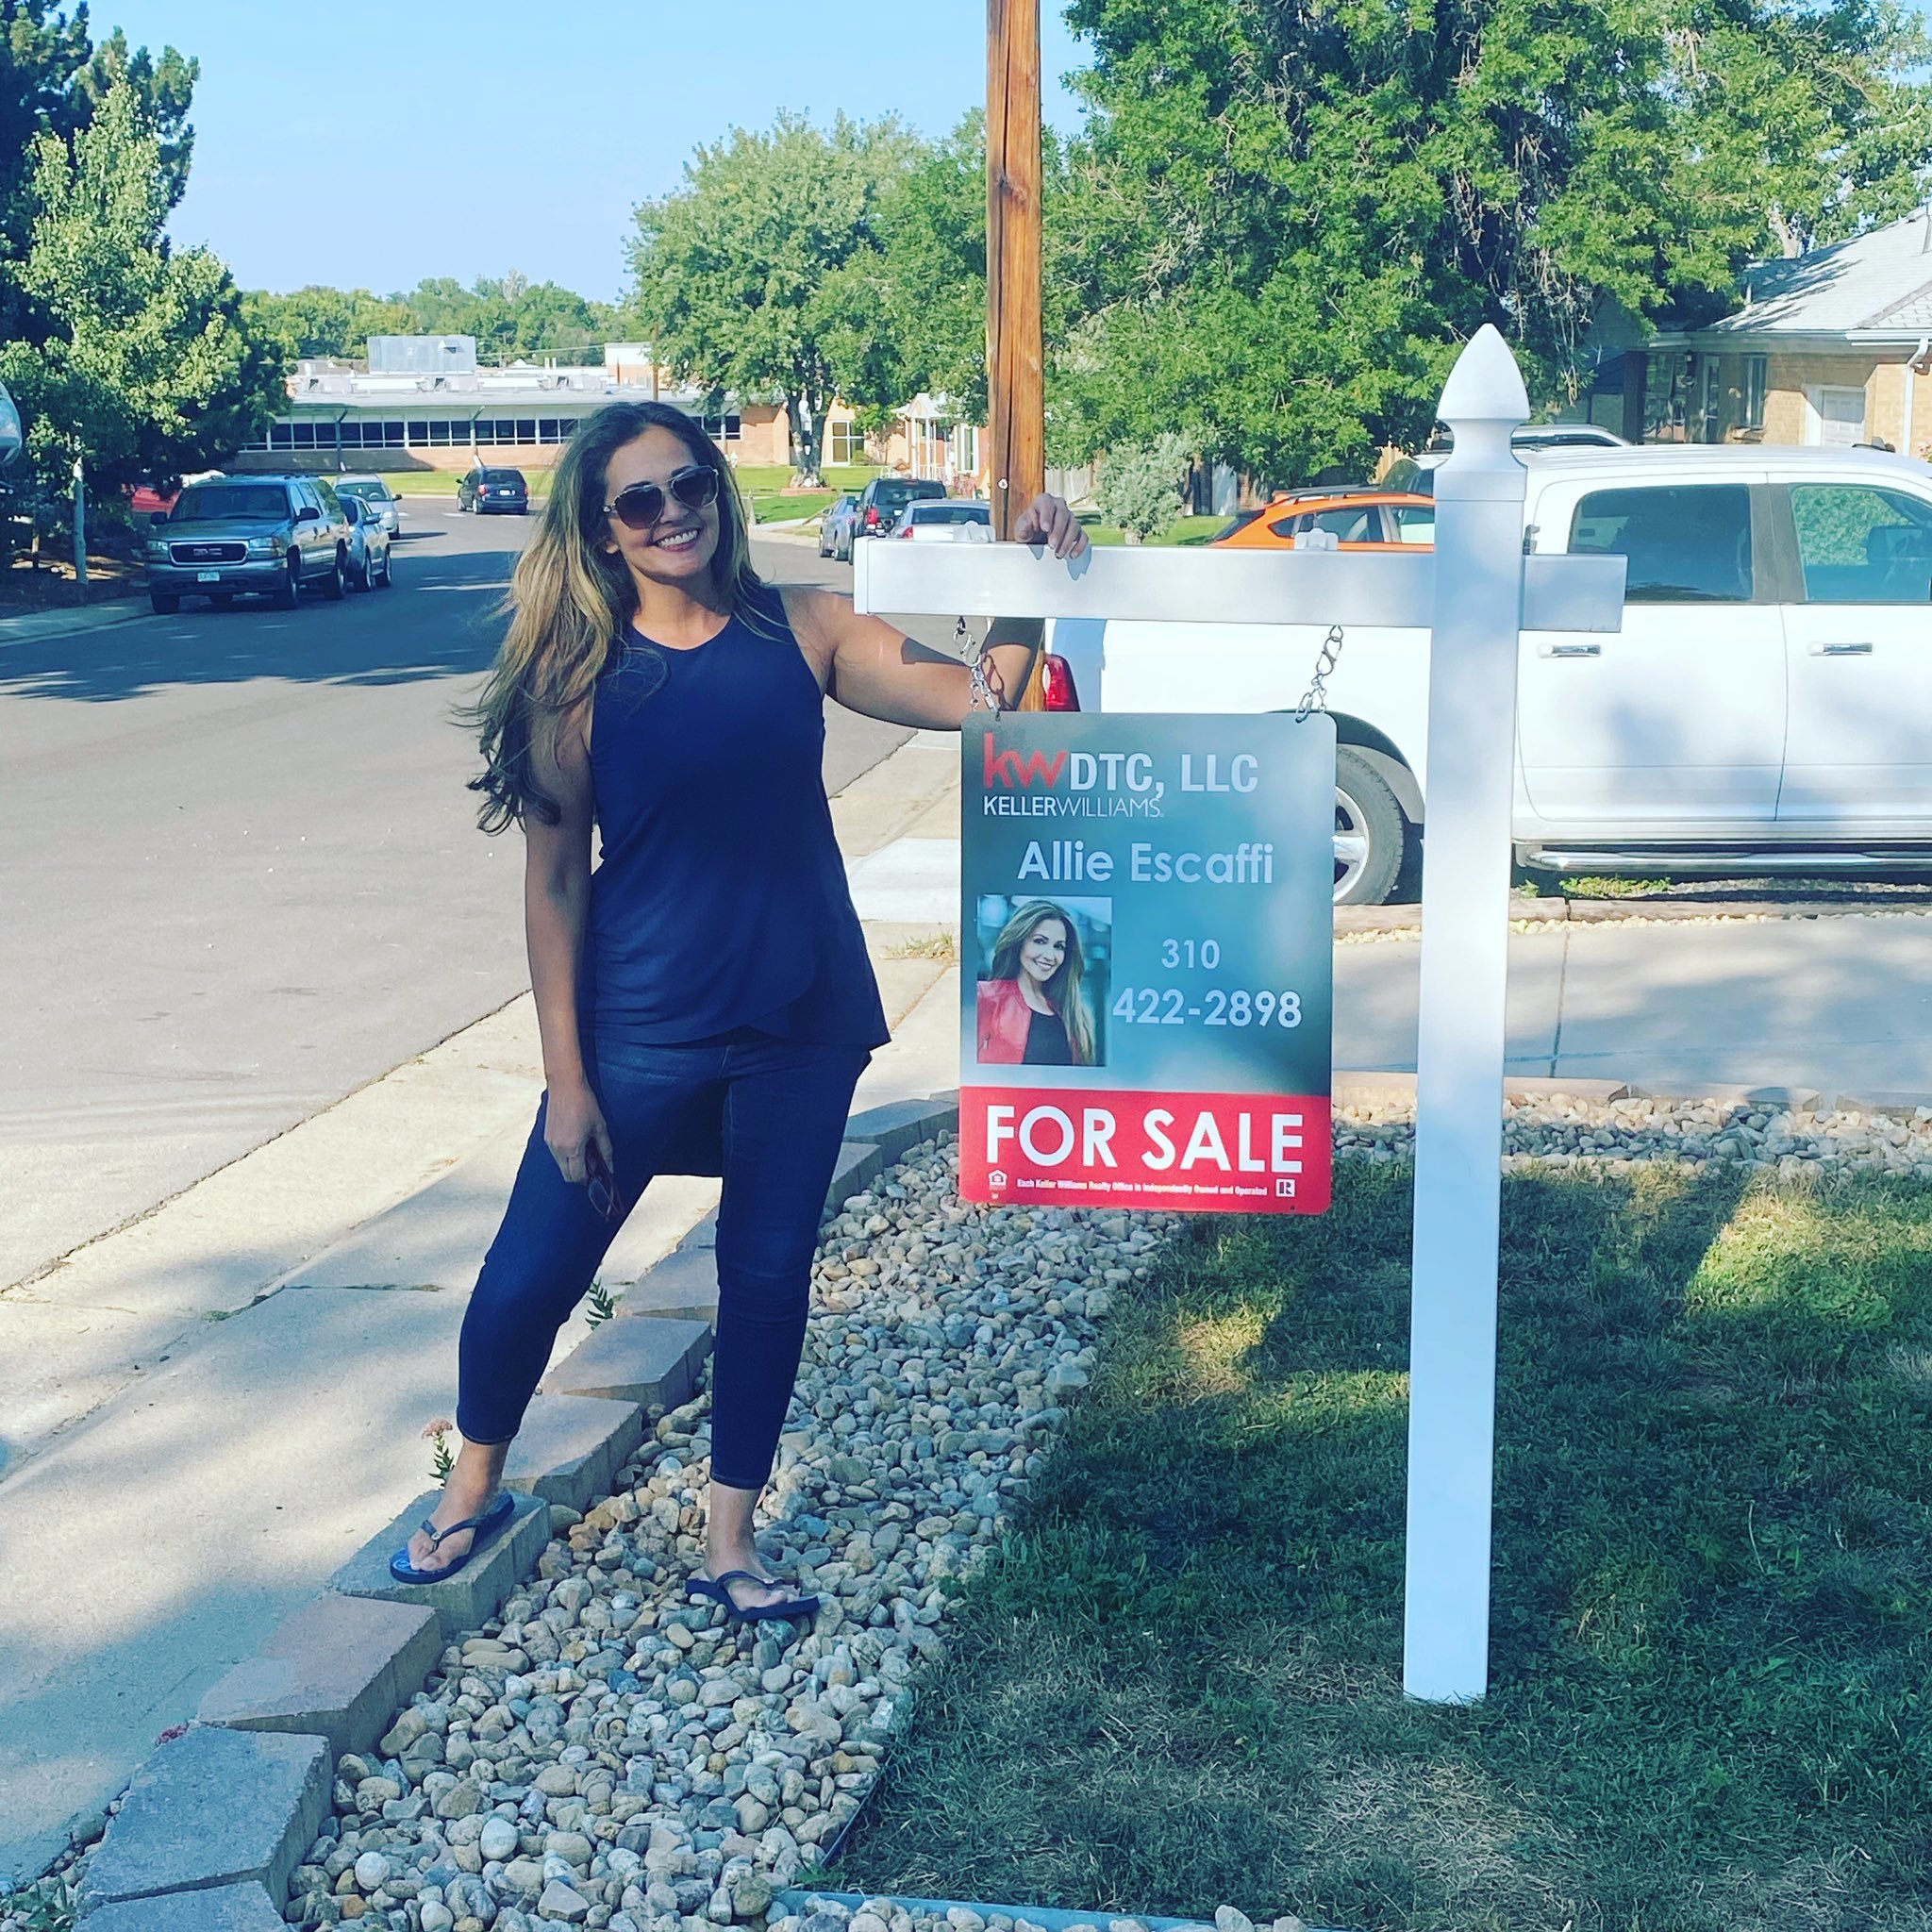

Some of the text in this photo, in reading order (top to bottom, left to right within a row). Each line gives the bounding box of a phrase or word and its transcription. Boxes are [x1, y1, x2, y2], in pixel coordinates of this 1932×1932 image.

[983, 732, 1258, 800] kw DTC, LLC
[1017, 840, 1274, 884] Allie Escaffi
[1161, 939, 1220, 969] 310
[1112, 988, 1302, 1028] 422-2898
[987, 1105, 1303, 1174] FOR SALE
